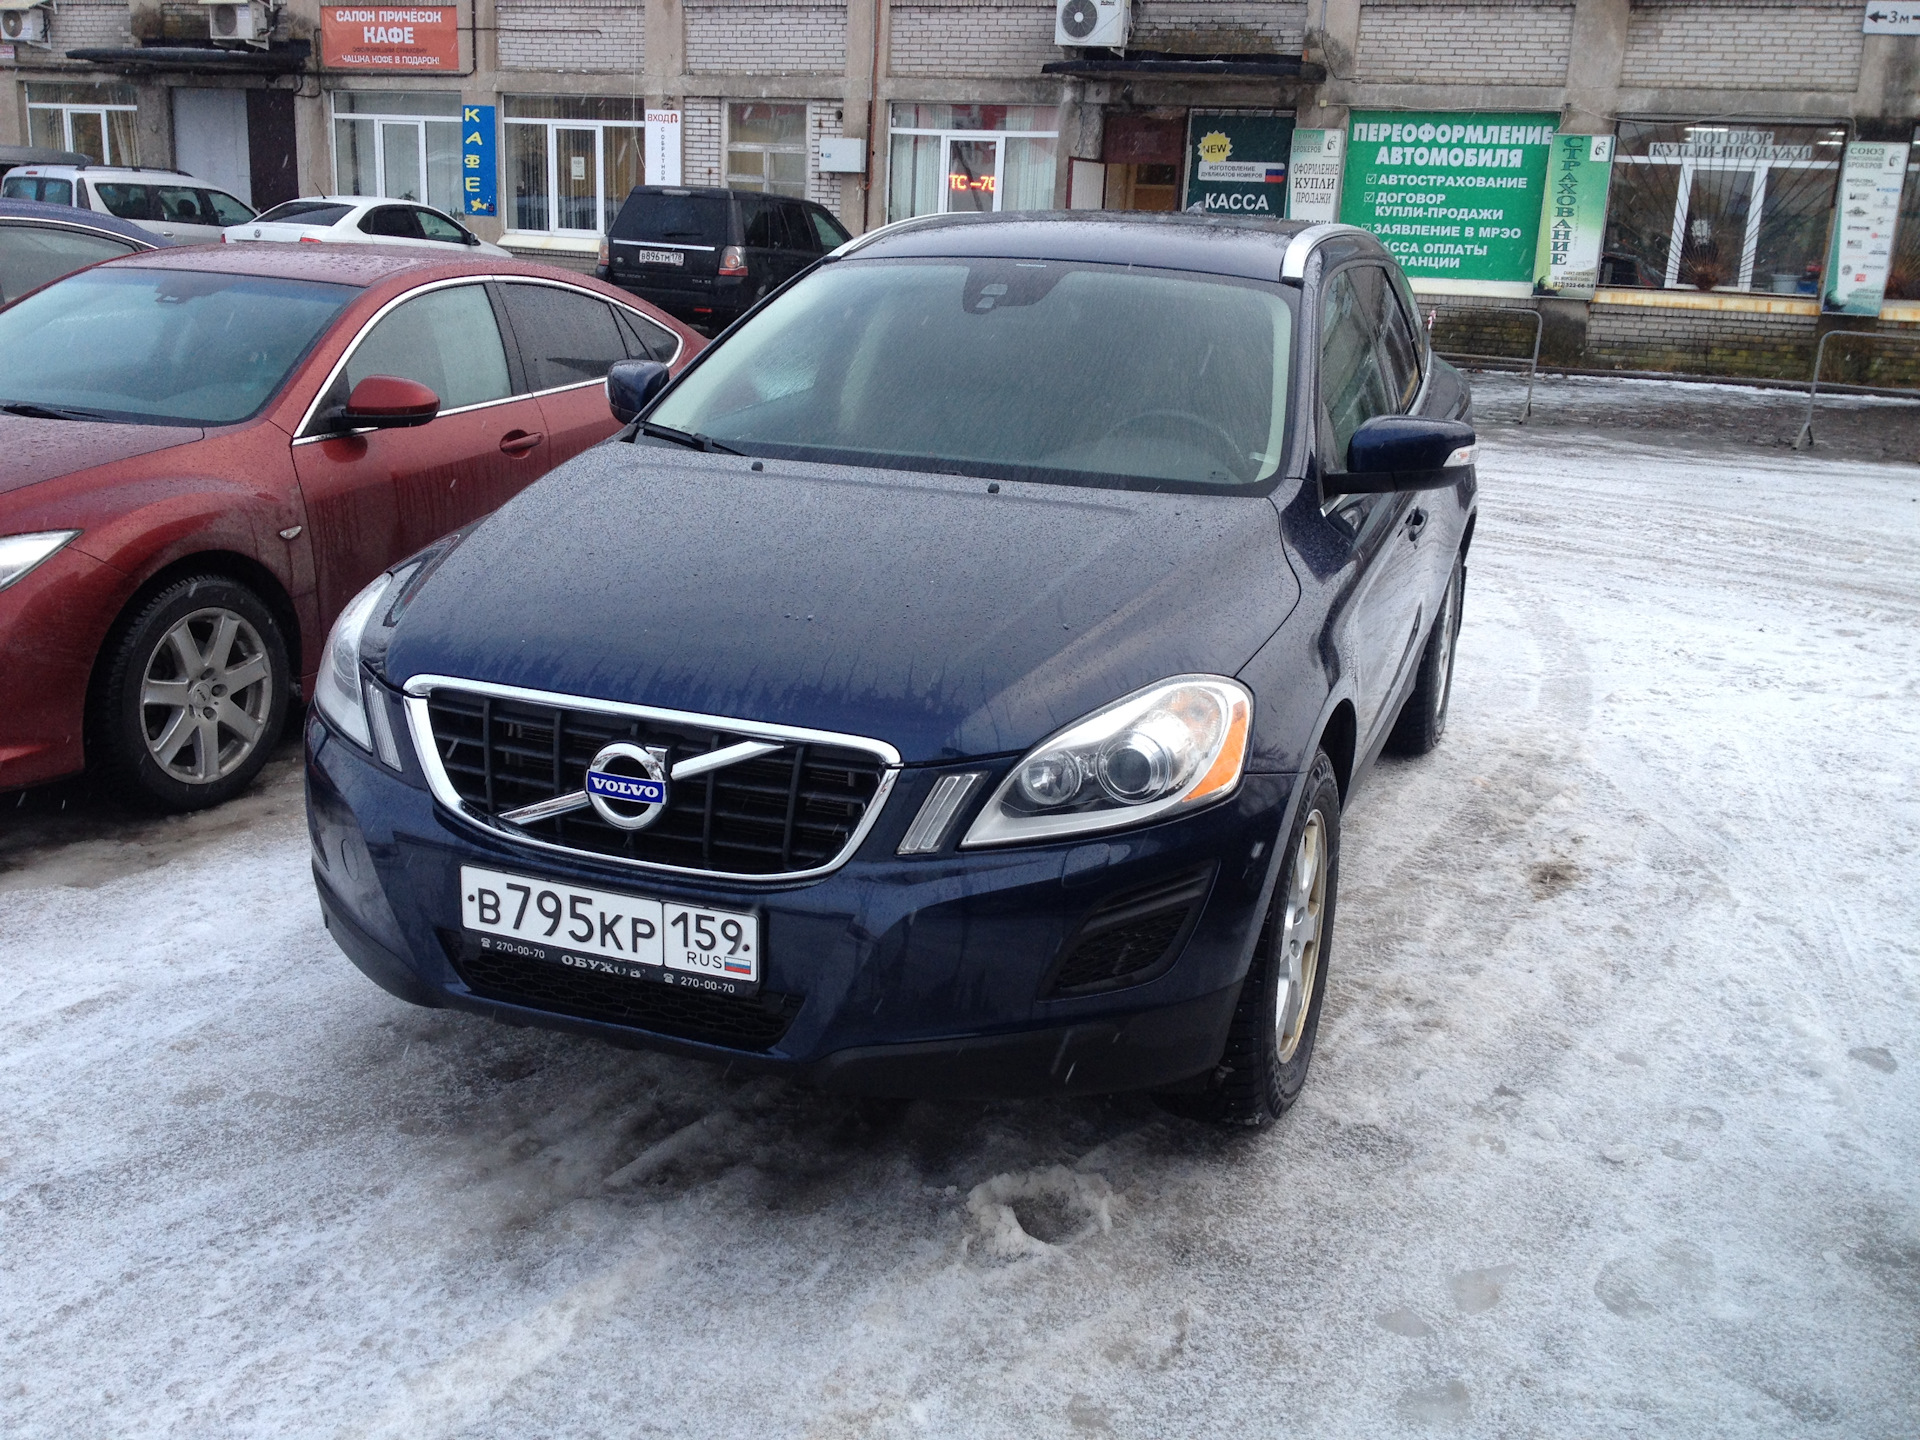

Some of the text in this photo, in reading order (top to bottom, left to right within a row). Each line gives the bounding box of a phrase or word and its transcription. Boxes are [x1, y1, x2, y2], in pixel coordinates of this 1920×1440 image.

[336, 8, 442, 23] САЛОН ПРИЧЁСОК
[1888, 10, 1898, 23] 3
[363, 26, 415, 44] КАФЕ
[341, 54, 440, 66] ЧАШКА КОФЕ В ПОДАРОК!
[647, 113, 670, 124] ВХОД
[1352, 122, 1553, 145] ПЕРЕОФОРМЛЕНИЕ
[1691, 131, 1773, 145] ДОГОВОР
[464, 107, 483, 193] КАФЕ
[1202, 143, 1228, 154] NEW
[1651, 143, 1812, 160] КУПЛИ-ПРОДАЖИ
[1850, 147, 1885, 156] СОЮЗ
[1374, 146, 1523, 168] АВТОМОБИЛЯ
[1293, 163, 1339, 176] ОФОРМЛЕНИЕ
[1294, 177, 1336, 190] КУПЛИ
[1377, 173, 1528, 189] АВТОСТРАХОВАНИЕ
[1204, 192, 1270, 211] КАССА
[1295, 191, 1332, 204] ПРОДАЖИ
[1375, 191, 1446, 205] ДОГОВОР
[1549, 136, 1585, 266] СТРАХОВАНИЕ
[1374, 205, 1504, 221] КУПЛИ-ПРОДАЖИ
[1373, 223, 1522, 239] ЗАЯВЛЕНИЕ В МРЭО
[1383, 241, 1489, 256] АССА ОПЛАТЫ
[1394, 255, 1461, 269] ТАНЦИИ
[590, 776, 660, 799] VOLVO
[477, 881, 745, 956] В795КР 159
[495, 939, 546, 960] 270-00-70
[686, 951, 723, 970] RUS
[679, 975, 736, 994] 270-00-70
